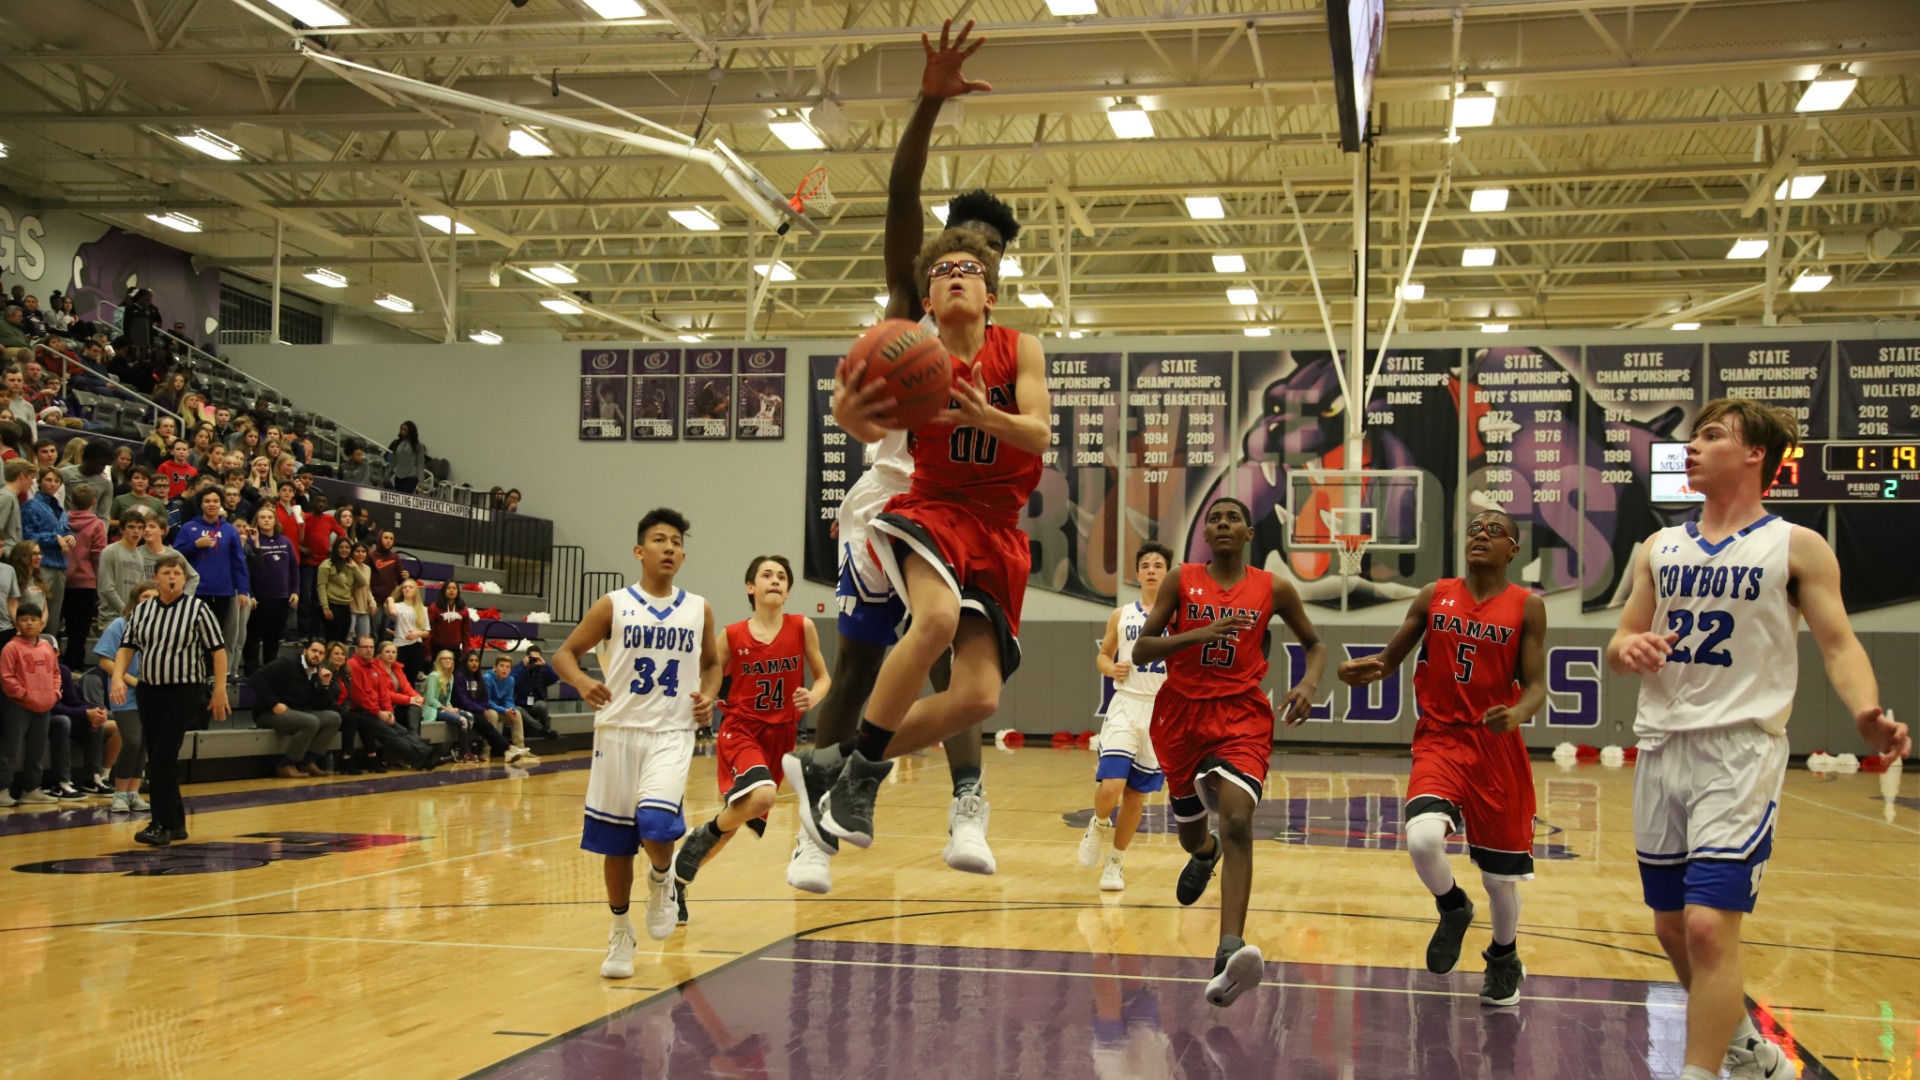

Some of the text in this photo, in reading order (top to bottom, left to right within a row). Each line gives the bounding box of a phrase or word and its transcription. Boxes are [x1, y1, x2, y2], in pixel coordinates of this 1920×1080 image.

[1624, 352, 1663, 367] STATE
[1748, 350, 1790, 365] STATE
[1879, 347, 1920, 362] STATE
[1052, 361, 1087, 374] STATE
[1162, 360, 1197, 373] STATE
[1387, 357, 1424, 371] STATE
[1504, 355, 1543, 369] STATE
[1478, 371, 1569, 385] CHAMPIONSHIPS
[1597, 369, 1690, 384] CHAMPIONSHIPS
[1720, 367, 1818, 382] CHAMPIONSHIPS
[1048, 377, 1111, 389] MPIONSHIPS
[1137, 376, 1221, 388] CHAMPIONSHIPS
[1387, 391, 1422, 405] DANCE
[1510, 389, 1572, 403] SWIMMING
[1630, 388, 1694, 401] SWIMMING
[1726, 386, 1811, 399] CHEERLEADING
[1054, 394, 1116, 406] BASKETBALL
[1164, 393, 1227, 406] BASKETBALL
[1486, 410, 1562, 424] 1972 1973
[1604, 409, 1632, 422] 1976
[1858, 405, 1888, 418] 2012
[1079, 414, 1104, 426] 1949
[1144, 413, 1214, 426] 1979 1993
[1368, 412, 1394, 425] 2016
[602, 426, 621, 436] 1990
[654, 426, 673, 436] 1996
[1858, 422, 1888, 435] 2016
[823, 434, 846, 445] 1952
[1078, 433, 1103, 445] 1978
[1144, 433, 1214, 445] 1994 2009
[1486, 430, 1562, 444] 1974 1976
[1605, 429, 1630, 442] 1981
[949, 425, 998, 465] 00
[824, 452, 845, 463] 1961
[1042, 452, 1104, 464] 87 2009
[1144, 452, 1214, 464] 2011 2015
[1486, 450, 1560, 463] 1978 1981
[1603, 449, 1632, 463] 1999
[1857, 446, 1916, 469] 1:19
[822, 470, 846, 482] 1963
[1144, 471, 1168, 483] 2017
[1485, 469, 1561, 483] 1985 1986
[1602, 470, 1633, 484] 2002
[1770, 489, 1799, 497] BONUS
[1847, 483, 1880, 491] PERIOD
[1884, 480, 1898, 498] 2
[822, 489, 845, 500] 2013
[1484, 489, 1561, 503] 2000 2001
[380, 492, 411, 507] WRESTLING
[412, 498, 444, 513] CONFERENCE
[821, 507, 839, 519] 201
[1659, 564, 1764, 601] COWBOYS
[1432, 613, 1514, 645] RAMAY
[623, 625, 694, 653] COWBOYS
[1666, 608, 1735, 667] 22
[742, 655, 800, 676] RAMAY
[1455, 642, 1476, 684] 5
[630, 656, 681, 697] 34
[755, 678, 784, 710] 24
